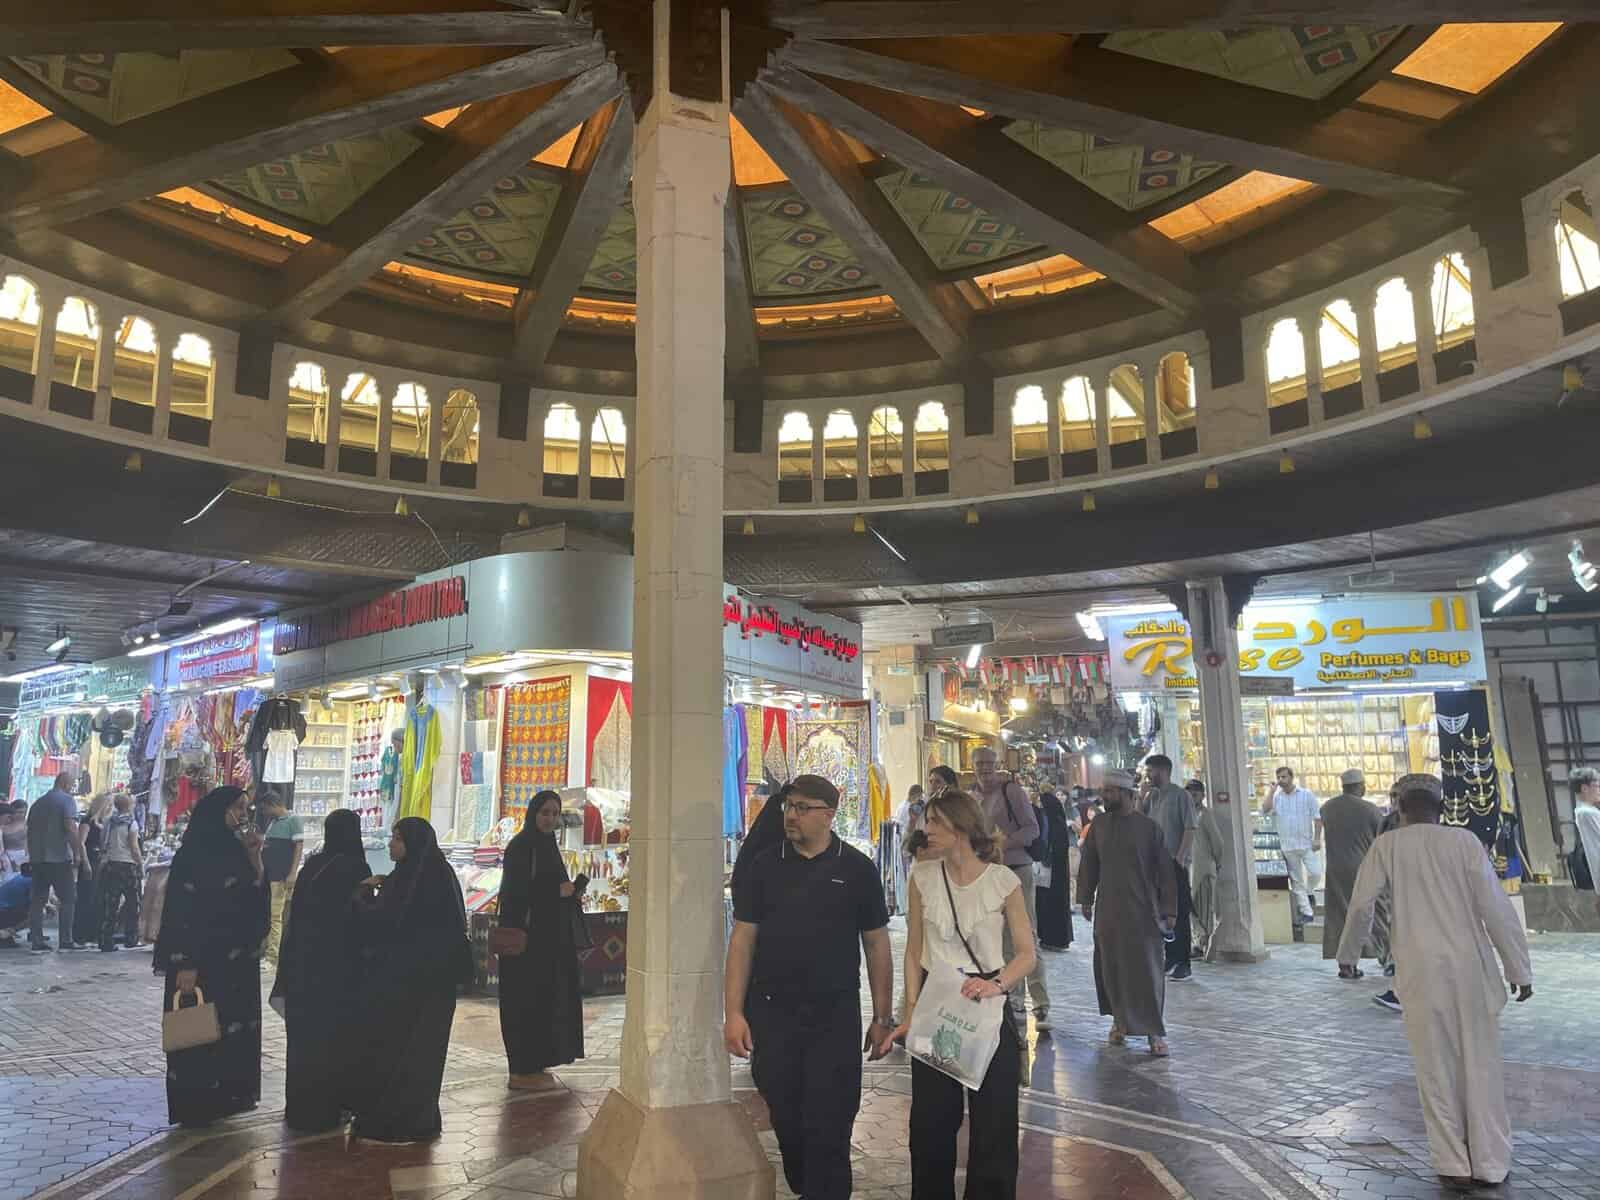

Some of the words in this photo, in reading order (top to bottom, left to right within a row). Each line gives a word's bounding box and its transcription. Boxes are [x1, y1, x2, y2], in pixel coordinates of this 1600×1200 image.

[1123, 617, 1185, 638] والحقائب
[1122, 635, 1304, 677] Rse
[1320, 652, 1405, 669] Perfumes
[1408, 649, 1423, 665] &
[1426, 649, 1472, 668] Bags
